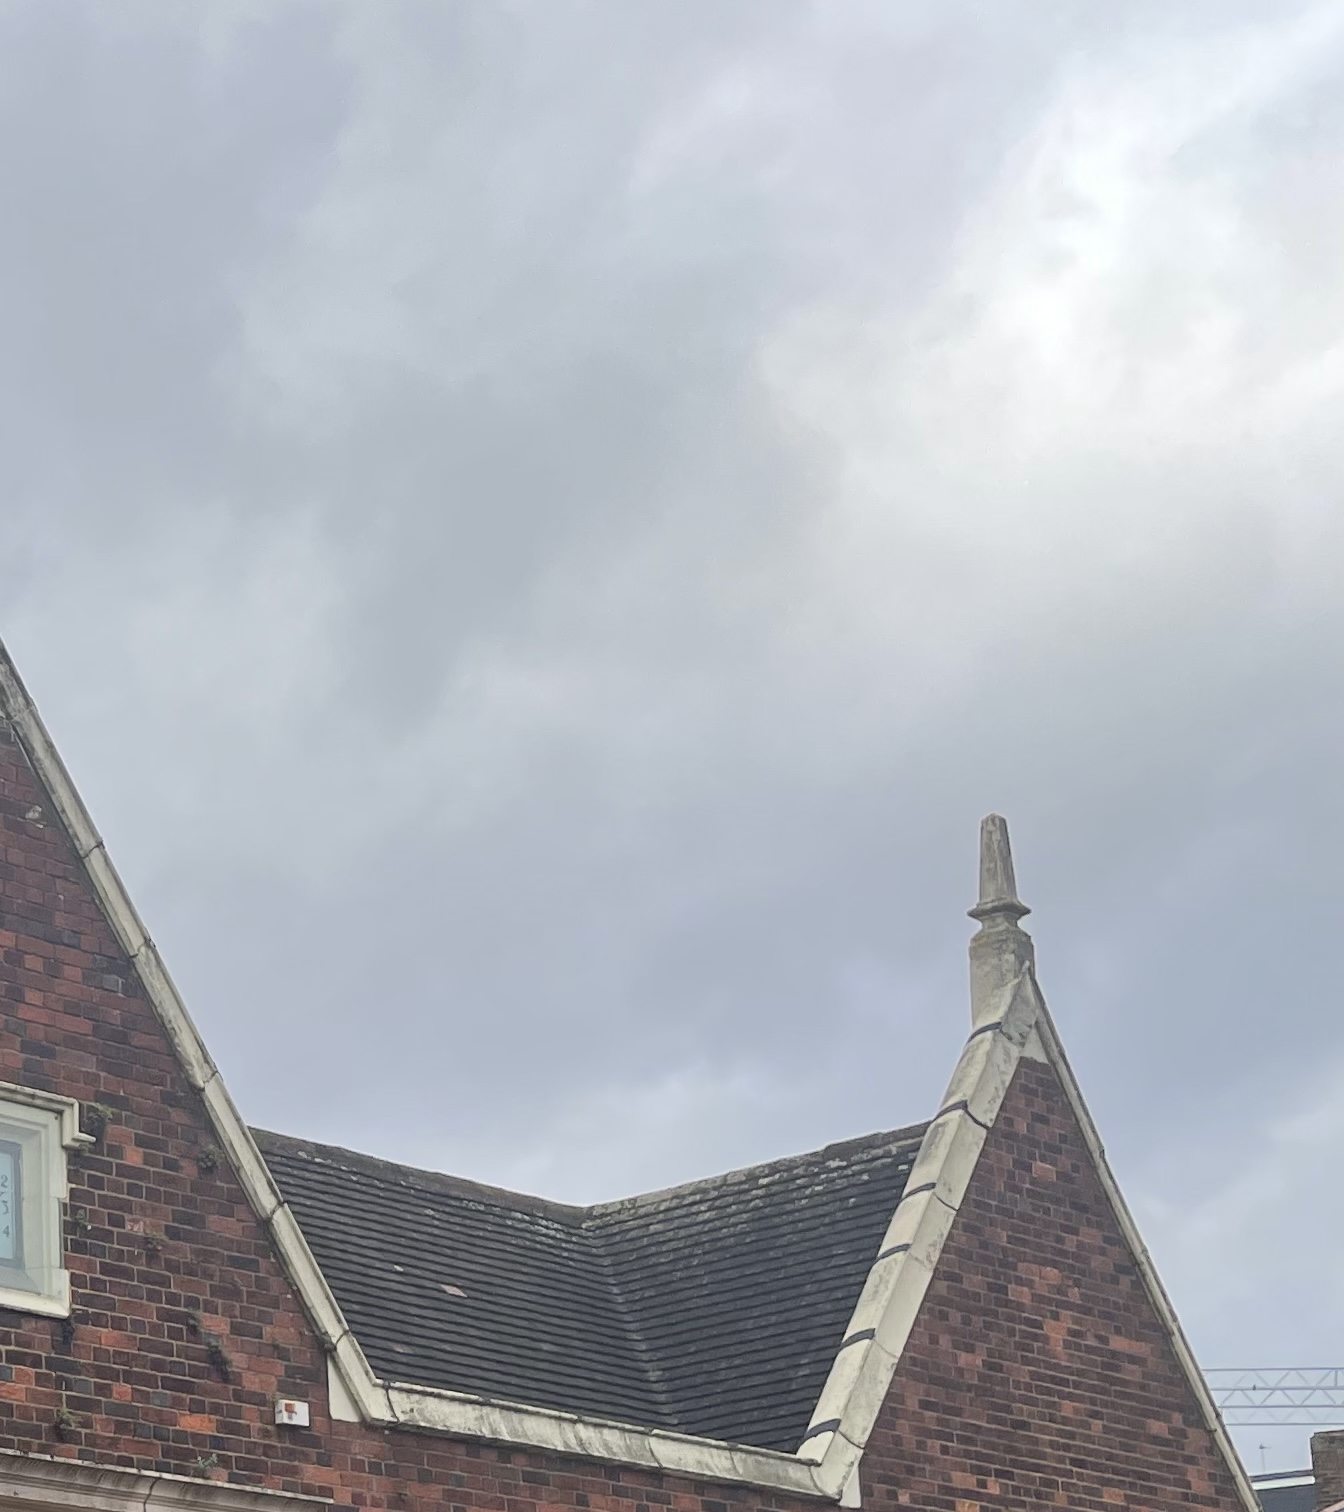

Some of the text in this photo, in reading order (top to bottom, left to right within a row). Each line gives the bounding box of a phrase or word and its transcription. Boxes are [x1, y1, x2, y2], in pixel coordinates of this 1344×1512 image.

[0, 1174, 9, 1188] 2
[1, 1200, 9, 1215] 3
[3, 1224, 10, 1238] 4
